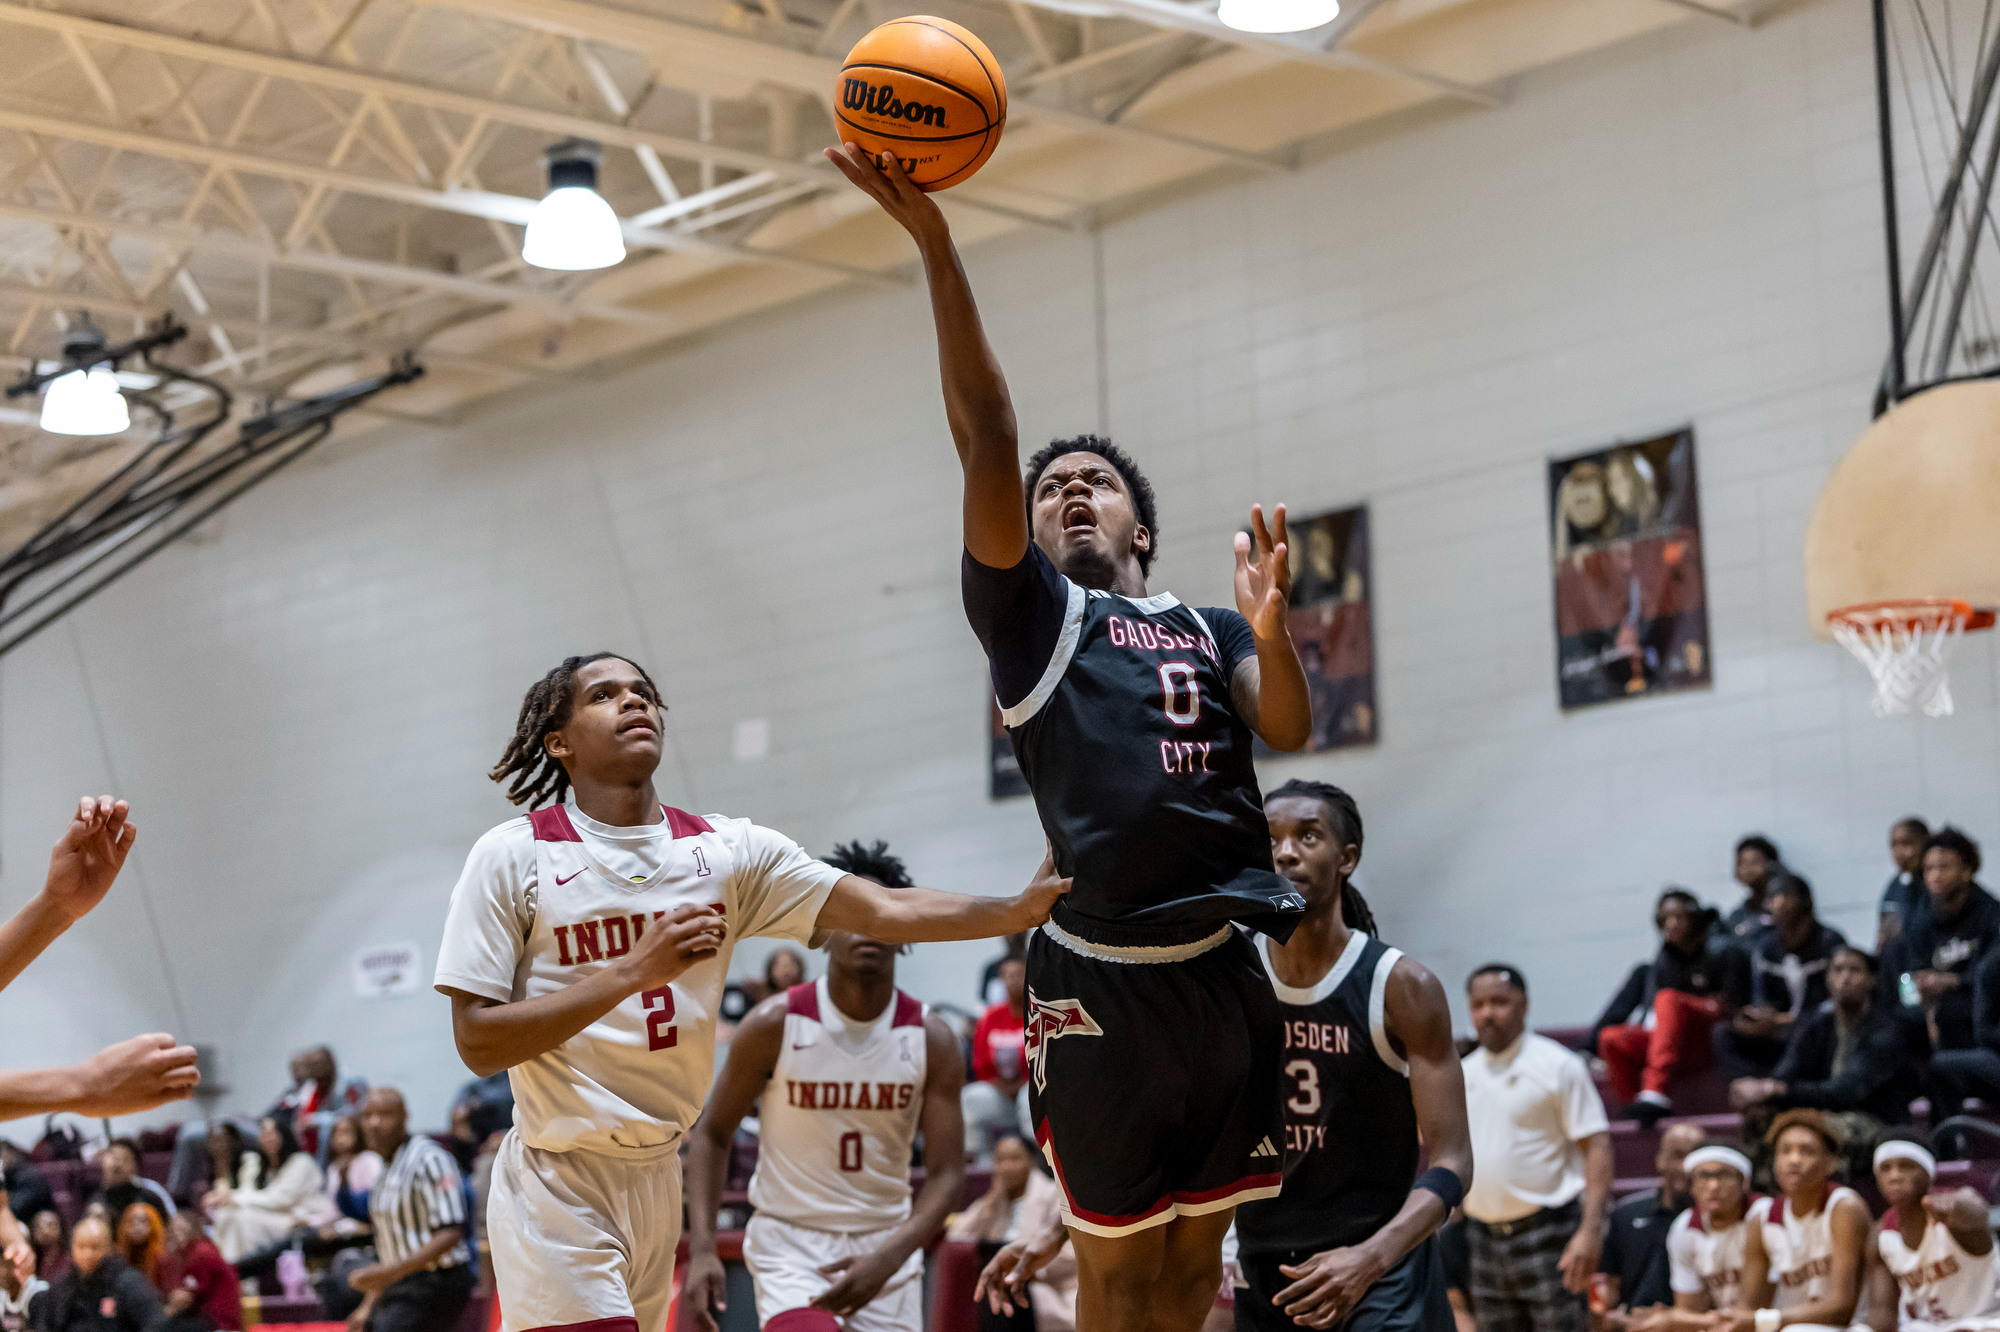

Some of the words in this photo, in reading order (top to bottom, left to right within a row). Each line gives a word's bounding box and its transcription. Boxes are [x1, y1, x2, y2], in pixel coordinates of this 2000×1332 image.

[843, 78, 946, 128] Wilson
[919, 154, 942, 164] NXT
[1157, 660, 1201, 727] 0
[1160, 739, 1211, 774] CITY
[692, 847, 711, 877] 1
[553, 902, 727, 966] INDI
[641, 984, 677, 1052] 2
[786, 1080, 914, 1110] INDIANS
[1284, 1058, 1322, 1115] 3
[840, 1130, 862, 1172] 0
[1285, 1124, 1328, 1153] CITY
